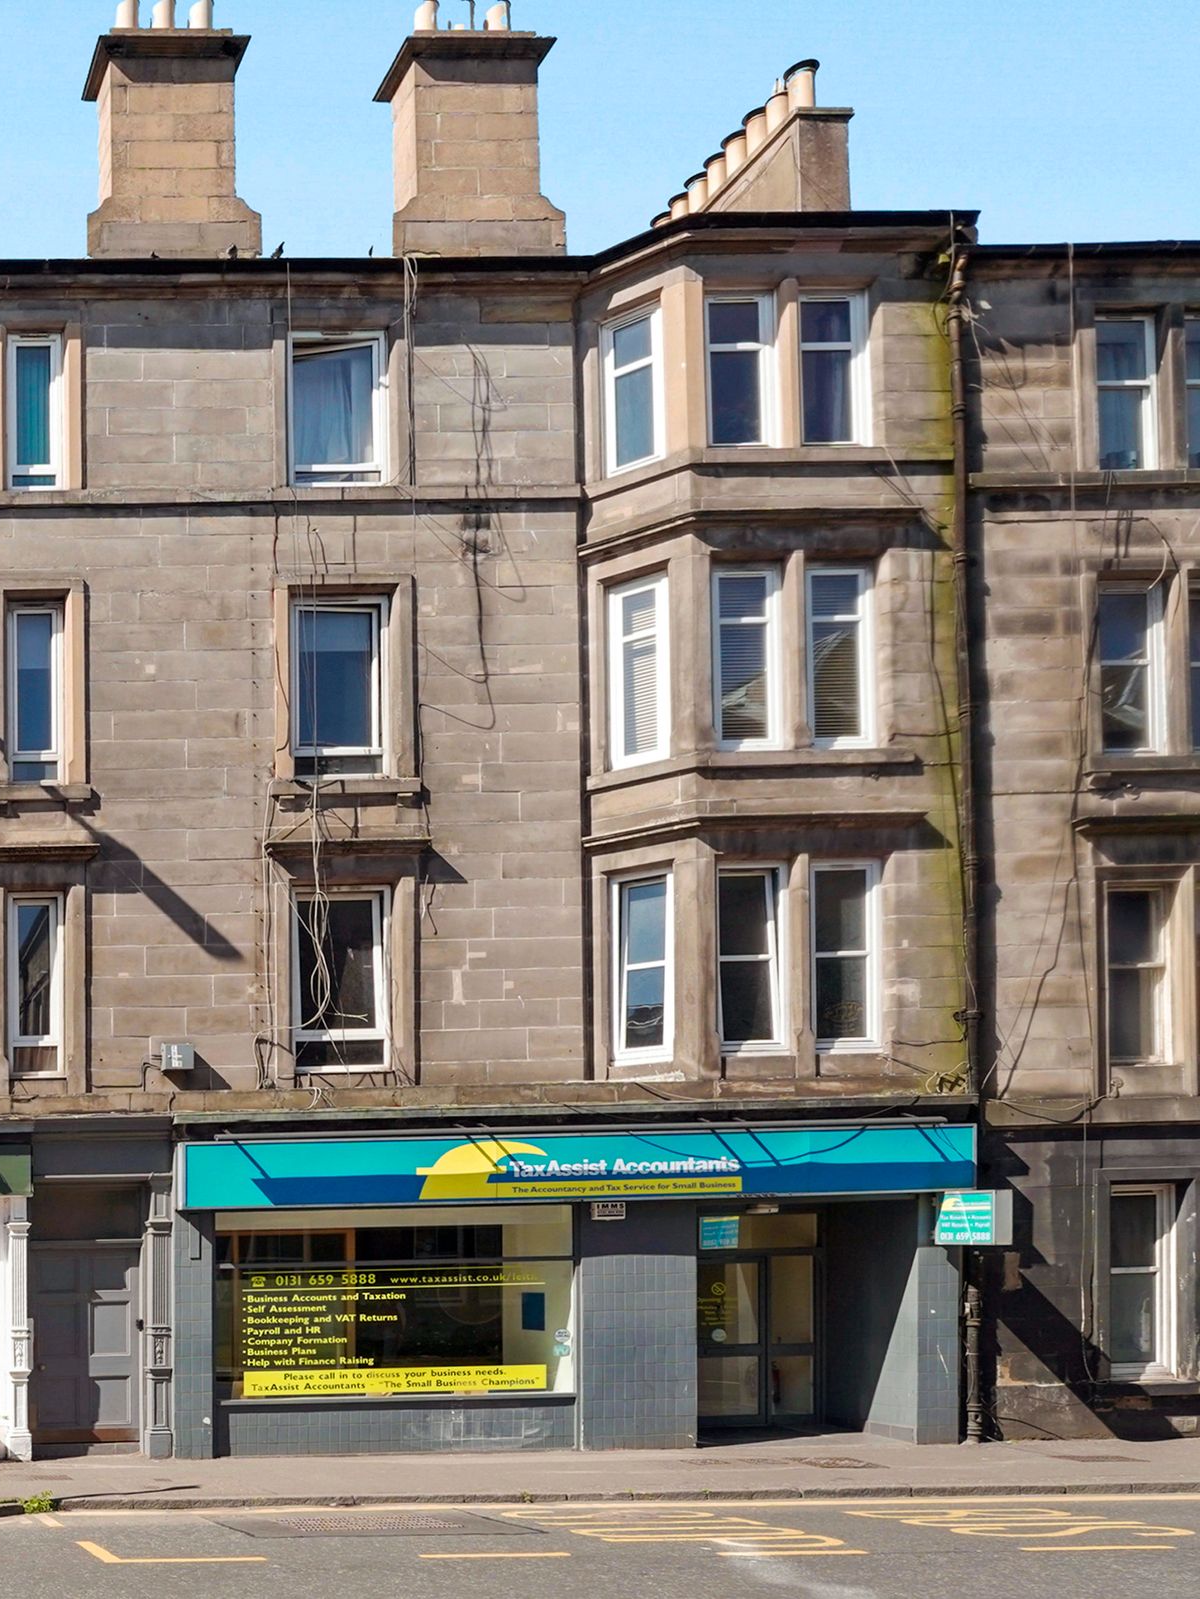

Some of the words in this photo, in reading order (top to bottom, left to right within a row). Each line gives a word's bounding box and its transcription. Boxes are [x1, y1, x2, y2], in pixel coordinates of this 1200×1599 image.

[509, 1158, 607, 1178] TaxAssist
[612, 1156, 741, 1175] Accountants
[530, 1185, 586, 1193] Accountancy
[623, 1183, 655, 1191] Service
[699, 1181, 736, 1189] Business
[275, 1275, 301, 1286] 0131
[308, 1274, 334, 1286] 659
[341, 1273, 377, 1285] 5888
[247, 1294, 288, 1303] Business
[291, 1293, 338, 1302] Accounts
[340, 1292, 359, 1301] and
[362, 1292, 406, 1301] Taxation
[247, 1304, 266, 1313] Self
[269, 1304, 327, 1313] Assessment
[247, 1316, 310, 1326] Bookkeeping
[313, 1315, 332, 1323] and
[335, 1315, 356, 1323] VAT
[359, 1314, 398, 1322] Returns
[247, 1327, 280, 1337] Payroll
[284, 1326, 302, 1335] and
[305, 1326, 321, 1334] HR
[247, 1338, 293, 1346] Company
[296, 1336, 348, 1345] Formation
[247, 1348, 288, 1356] Business
[291, 1347, 317, 1355] Plans
[247, 1359, 270, 1368] Help
[273, 1358, 296, 1366] with
[298, 1357, 336, 1366] Finance
[339, 1356, 375, 1366] Raising
[339, 1371, 349, 1379] in
[366, 1370, 400, 1378] discuss
[404, 1371, 427, 1379] your
[431, 1369, 471, 1377] business
[475, 1368, 507, 1376] needs.
[251, 1383, 300, 1392] TaxAssist
[304, 1382, 366, 1391] Accountants
[406, 1380, 432, 1388] Small
[436, 1379, 477, 1387] Business
